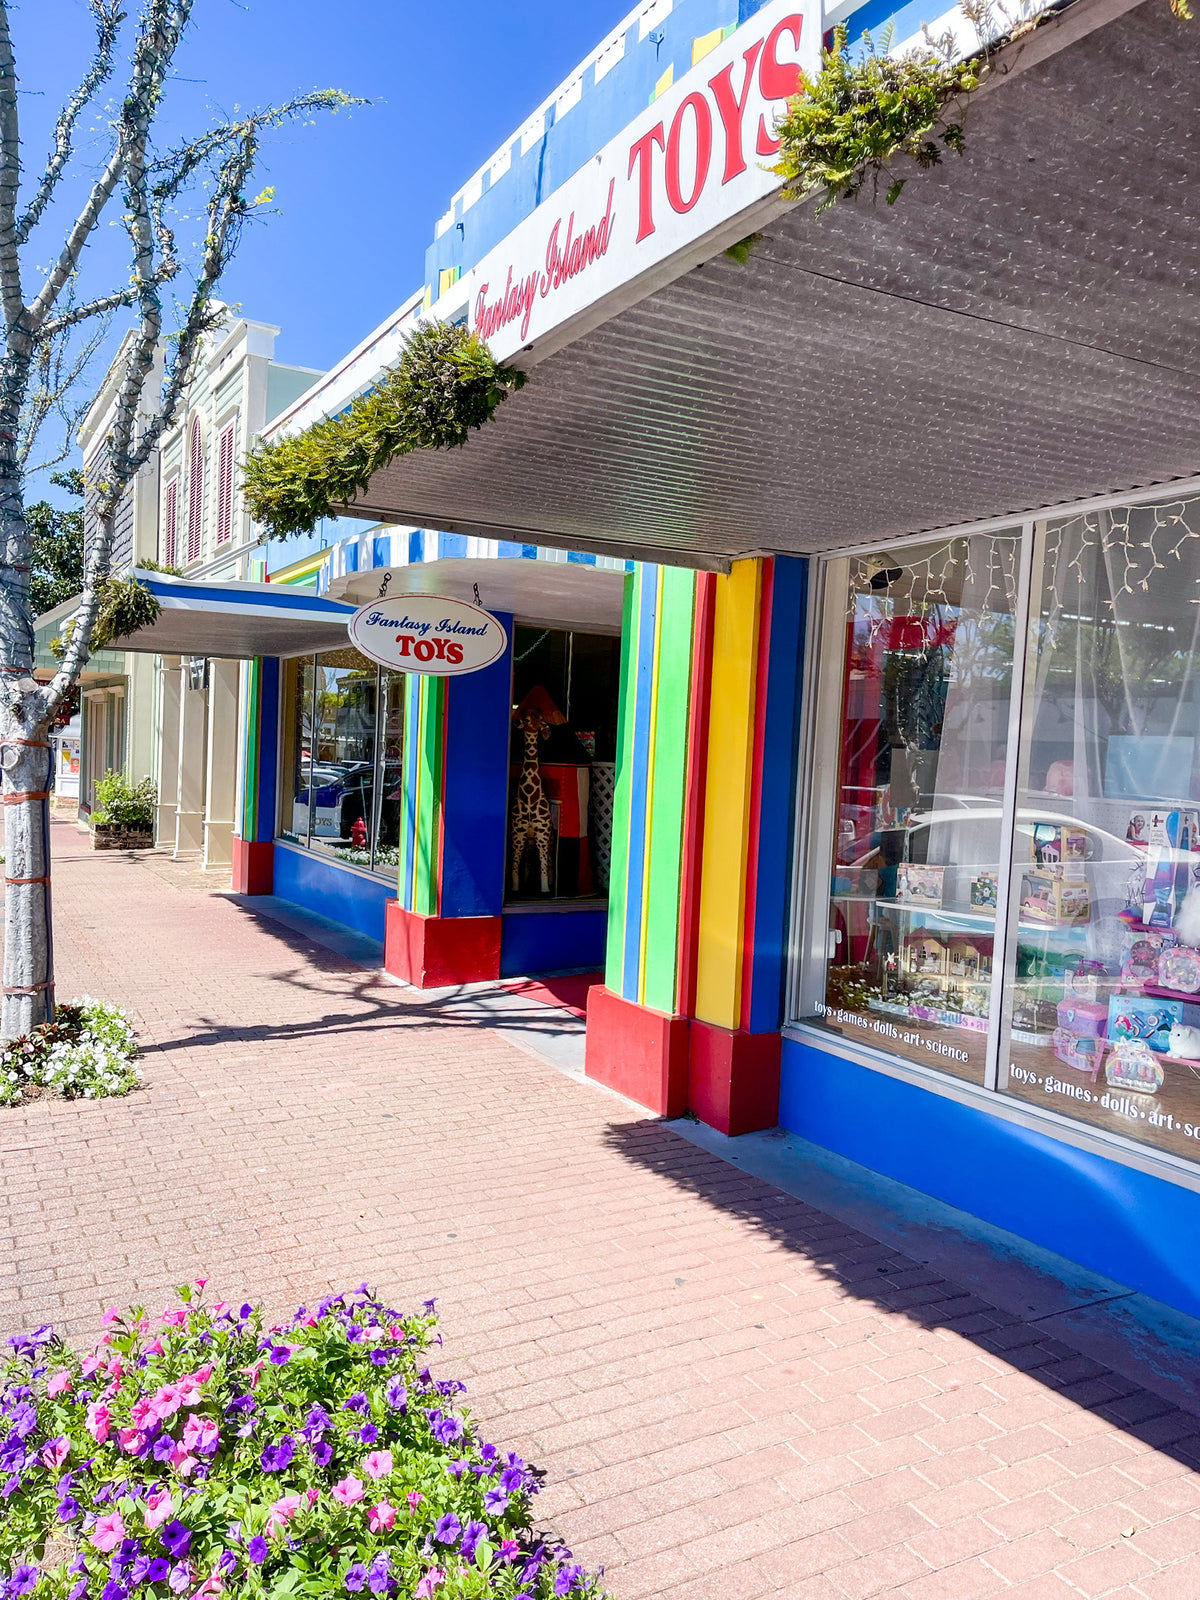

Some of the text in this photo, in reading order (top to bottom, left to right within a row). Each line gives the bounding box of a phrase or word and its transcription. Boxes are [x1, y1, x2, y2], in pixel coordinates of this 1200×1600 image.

[473, 14, 803, 341] Fantasy Island TOYS
[366, 611, 489, 636] Fantasy Island
[396, 634, 464, 664] TOYS
[814, 1001, 969, 1063] toys games dolls art science
[1010, 1063, 1200, 1140] toys games dolls art sc
